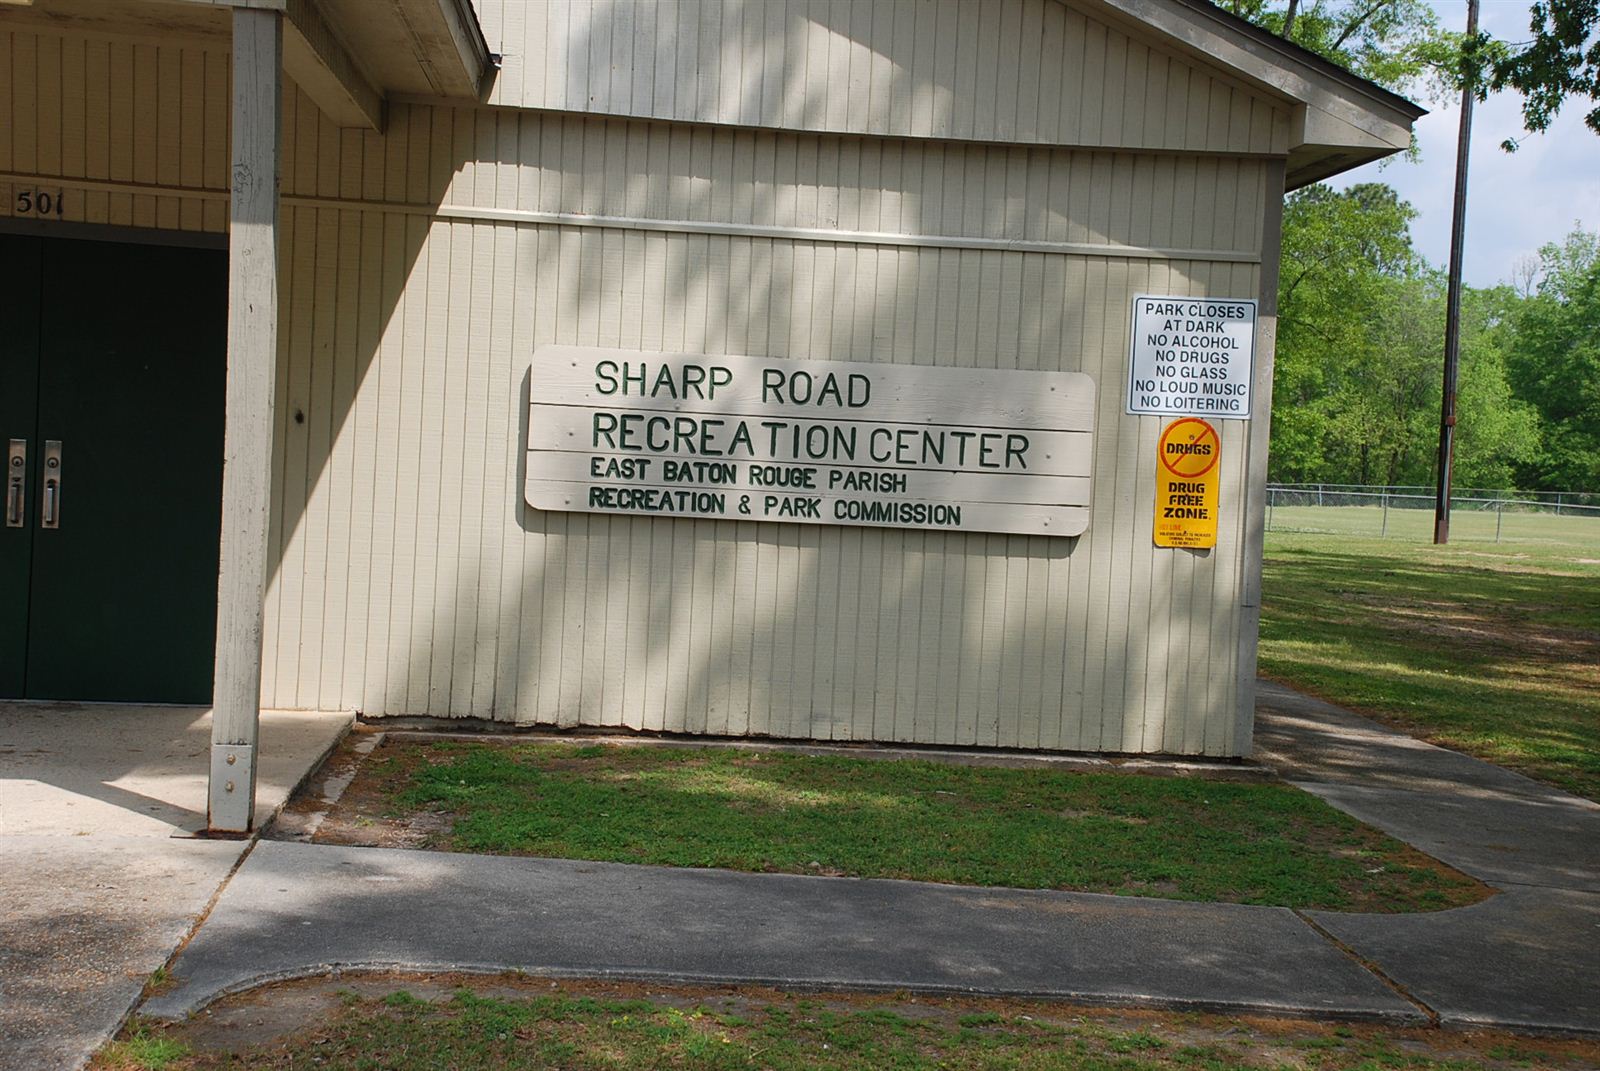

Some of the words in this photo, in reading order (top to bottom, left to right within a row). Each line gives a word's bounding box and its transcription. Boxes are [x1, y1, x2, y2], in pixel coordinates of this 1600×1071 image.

[16, 191, 64, 215] 501
[1145, 303, 1184, 316] PARK
[1188, 304, 1245, 319] CLOSES
[1163, 320, 1182, 331] AT
[1186, 321, 1225, 333] DARK
[1147, 334, 1168, 346] NO
[1172, 336, 1239, 349] ALCOHOL
[1155, 350, 1176, 362] NO
[1180, 351, 1230, 364] DRUGS
[1156, 366, 1176, 377] NO
[1180, 367, 1228, 380] GLASS
[595, 360, 733, 401] SHARP
[761, 368, 872, 409] ROAD
[1135, 380, 1156, 392] NO
[1160, 382, 1198, 394] LOUD
[1202, 383, 1247, 396] MUSIC
[1140, 396, 1161, 408] NO
[1165, 397, 1240, 410] LOITERING
[593, 412, 858, 461] RECREATION
[869, 428, 1030, 470] CENTER
[1166, 443, 1212, 456] DRUGS
[590, 457, 651, 480] EAST
[663, 461, 737, 485] BATON
[749, 465, 817, 489] ROUGE
[829, 470, 907, 493] PARISH
[1168, 482, 1205, 493] DRUG
[589, 487, 726, 514] RECREATION
[738, 495, 751, 514] &
[764, 496, 822, 519] PARK
[834, 499, 962, 526] COMMISSION
[1169, 494, 1204, 506] FREE
